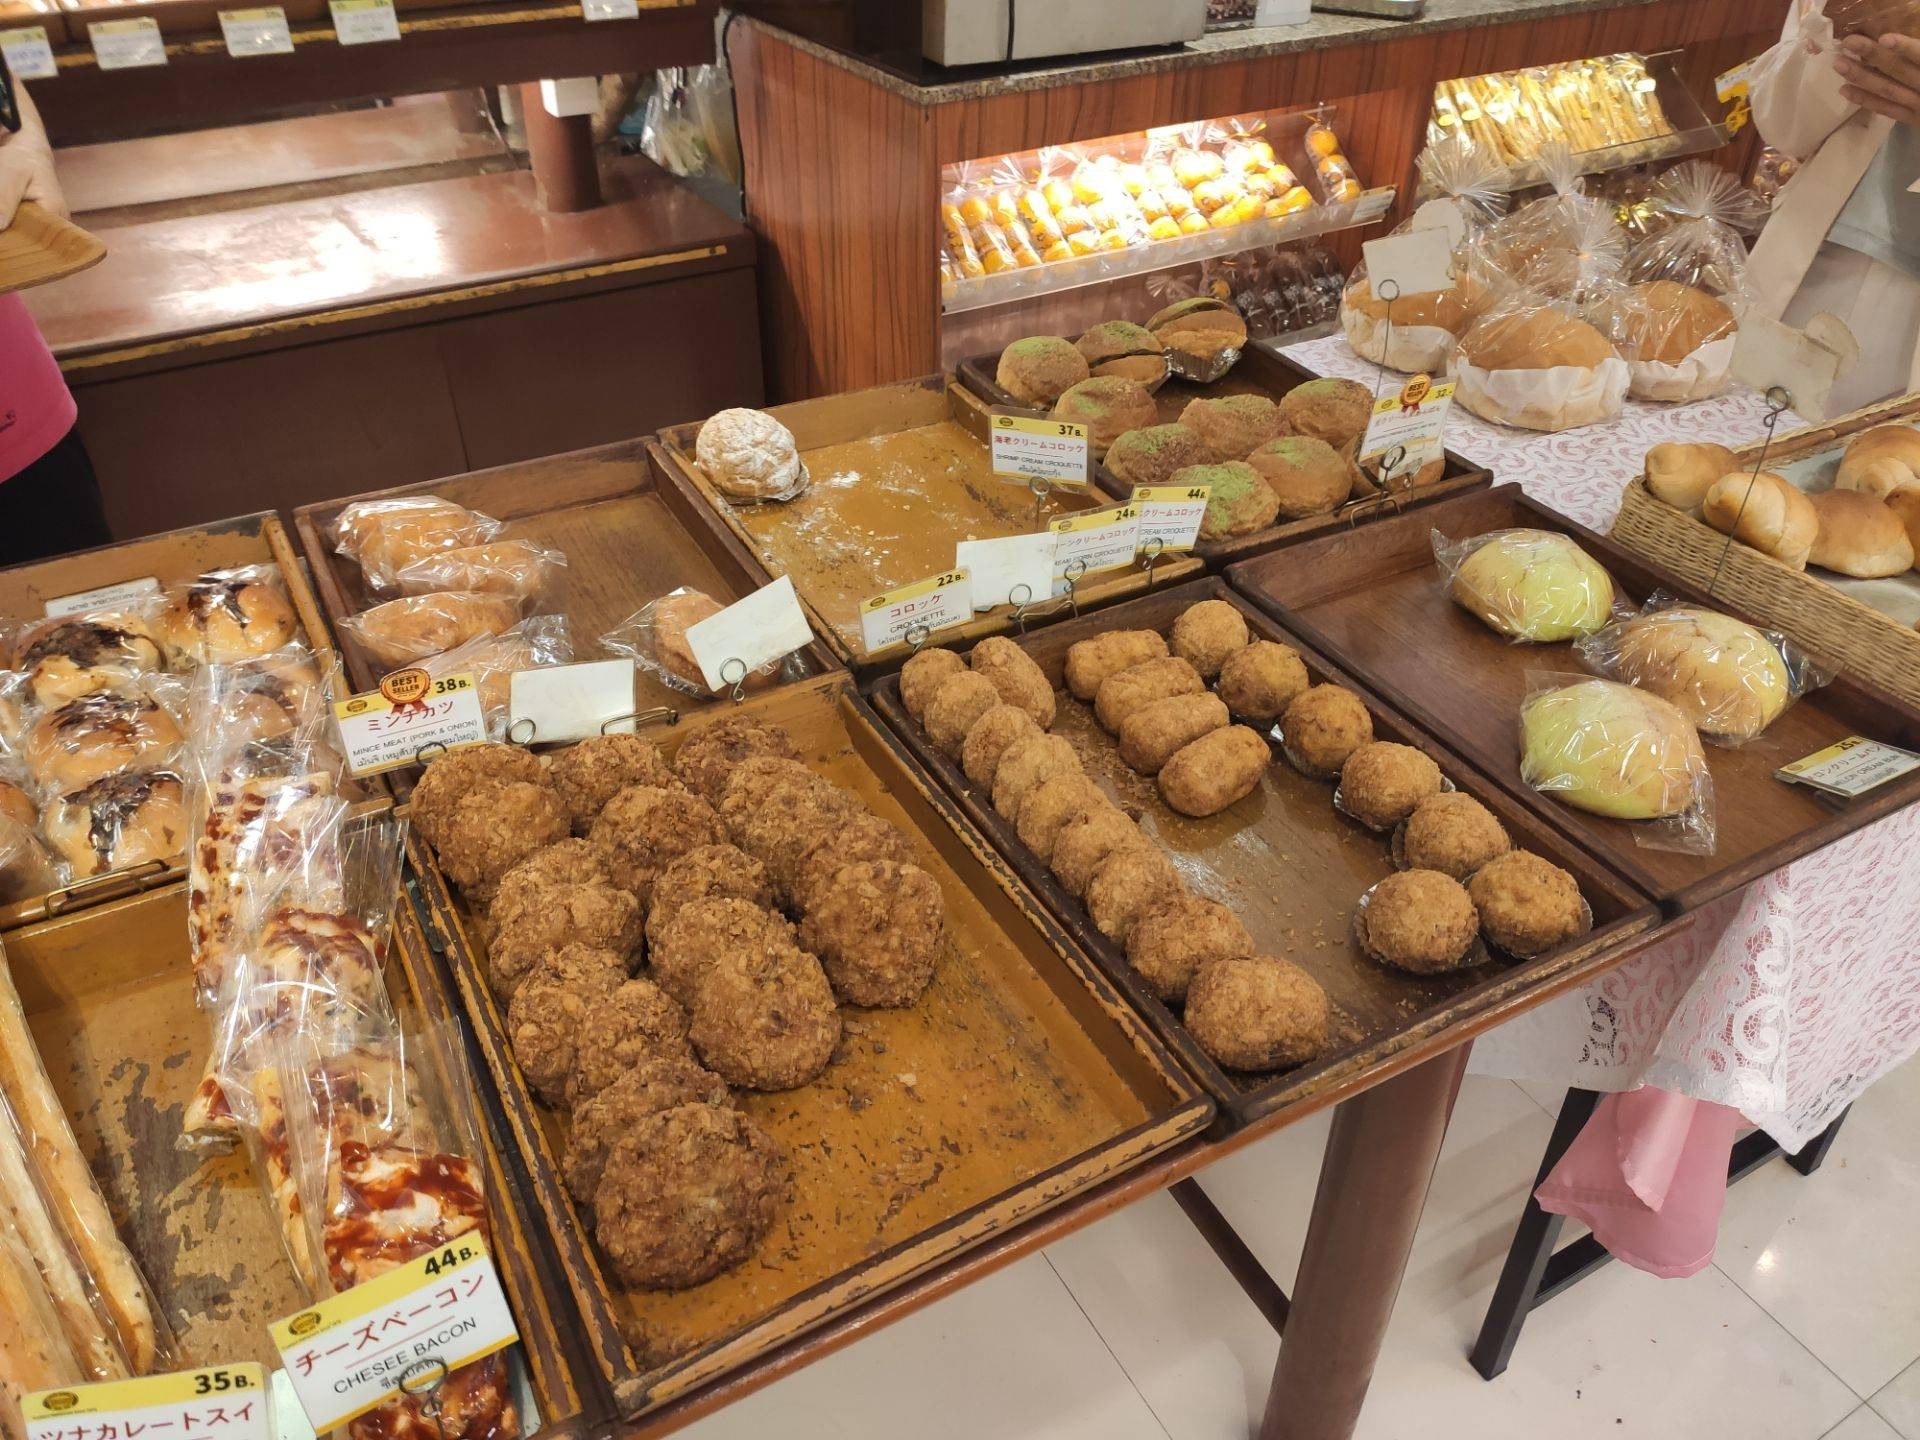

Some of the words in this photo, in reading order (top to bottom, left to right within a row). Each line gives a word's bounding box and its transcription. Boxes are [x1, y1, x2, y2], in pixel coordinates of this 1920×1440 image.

[994, 435, 1085, 453] 海老クリームコロッケ
[996, 453, 1019, 461] SHRIMP
[1021, 456, 1043, 465] CREAM
[1044, 460, 1083, 469] CROQUETTE
[1140, 508, 1202, 518] クリームコロッケ
[890, 593, 944, 618] コロッケ
[890, 609, 946, 634] CROQUETTE
[391, 675, 418, 687] BEST
[392, 683, 420, 694] SELLER
[367, 700, 454, 731] ミンチカツ
[352, 743, 381, 756] MINCE
[383, 737, 408, 749] MEAT
[410, 730, 437, 744] (PORK
[439, 727, 446, 735] &
[447, 720, 478, 733] ONION)
[295, 1274, 484, 1377] チーズベーコン
[333, 1349, 411, 1394] CHESEE
[413, 1316, 477, 1357] BACON
